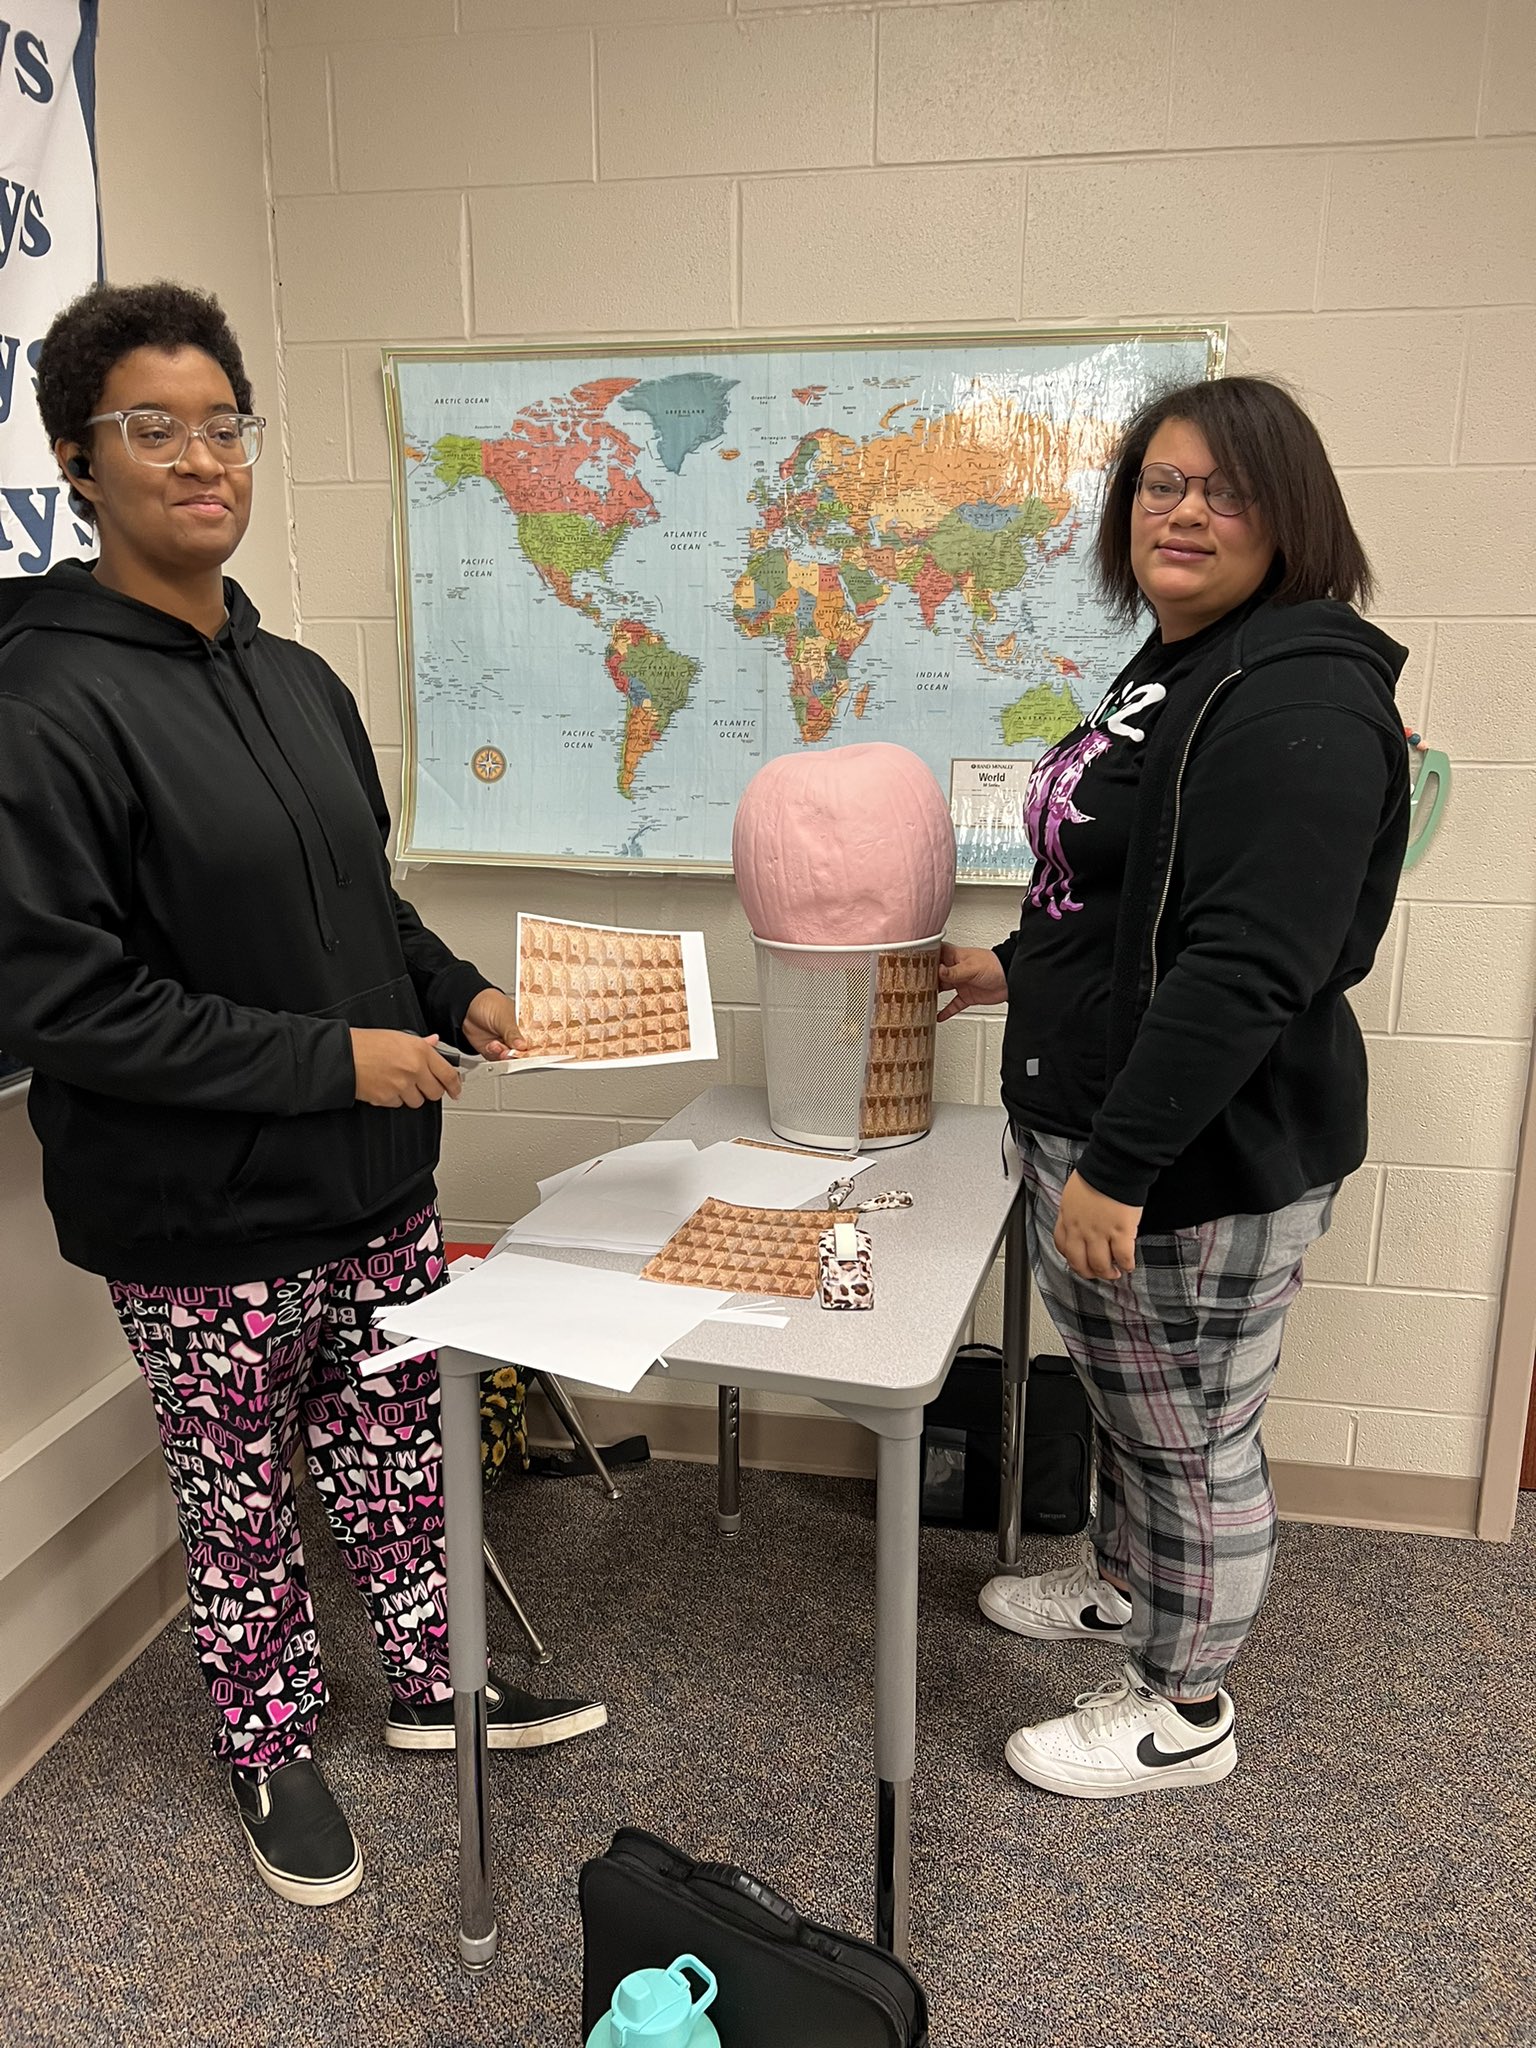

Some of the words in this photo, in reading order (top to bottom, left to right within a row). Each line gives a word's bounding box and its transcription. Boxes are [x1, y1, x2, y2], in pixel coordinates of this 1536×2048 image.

[663, 530, 708, 538] ATLANTIC
[670, 543, 702, 551] OCEAN
[712, 719, 757, 727] ATLANTIC
[719, 731, 750, 739] OCEAN
[978, 772, 1006, 782] World
